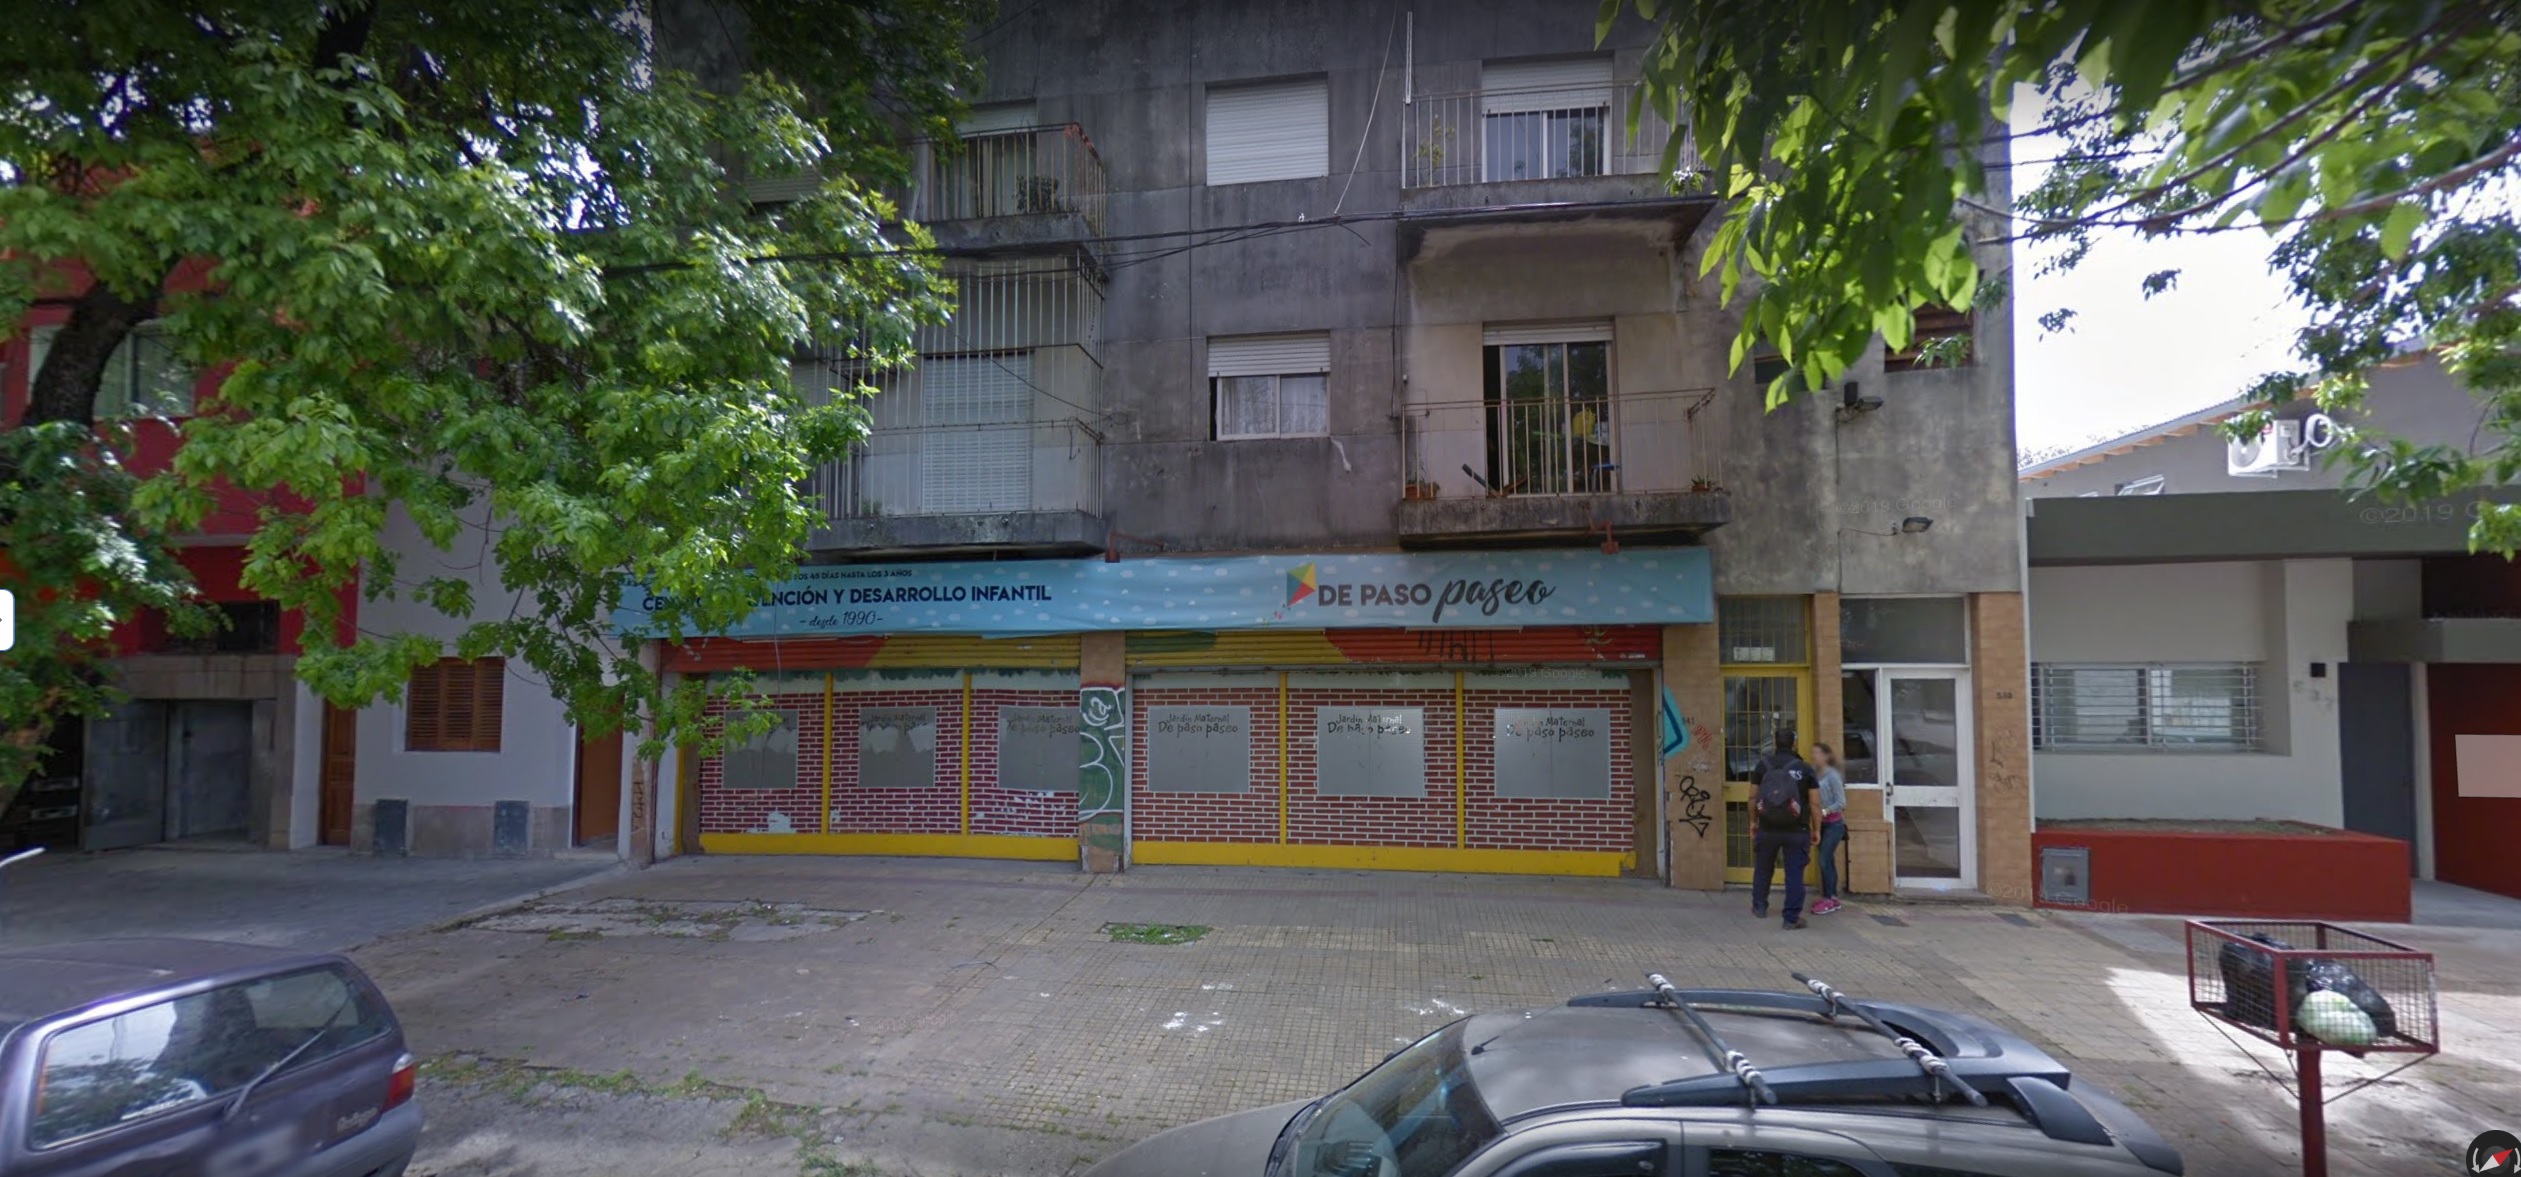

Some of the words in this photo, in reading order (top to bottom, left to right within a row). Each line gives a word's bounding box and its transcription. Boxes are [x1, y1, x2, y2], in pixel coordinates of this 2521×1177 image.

[841, 571, 865, 579] HASTA
[890, 568, 913, 577] AÑOS
[833, 589, 845, 604] Y
[850, 586, 967, 604] DESARROLLO
[972, 585, 1052, 602] INFANTIL
[1318, 584, 1353, 606] DE
[1360, 583, 1432, 606] PASO
[1432, 578, 1557, 623] paseo
[1206, 722, 1239, 738] paseo
